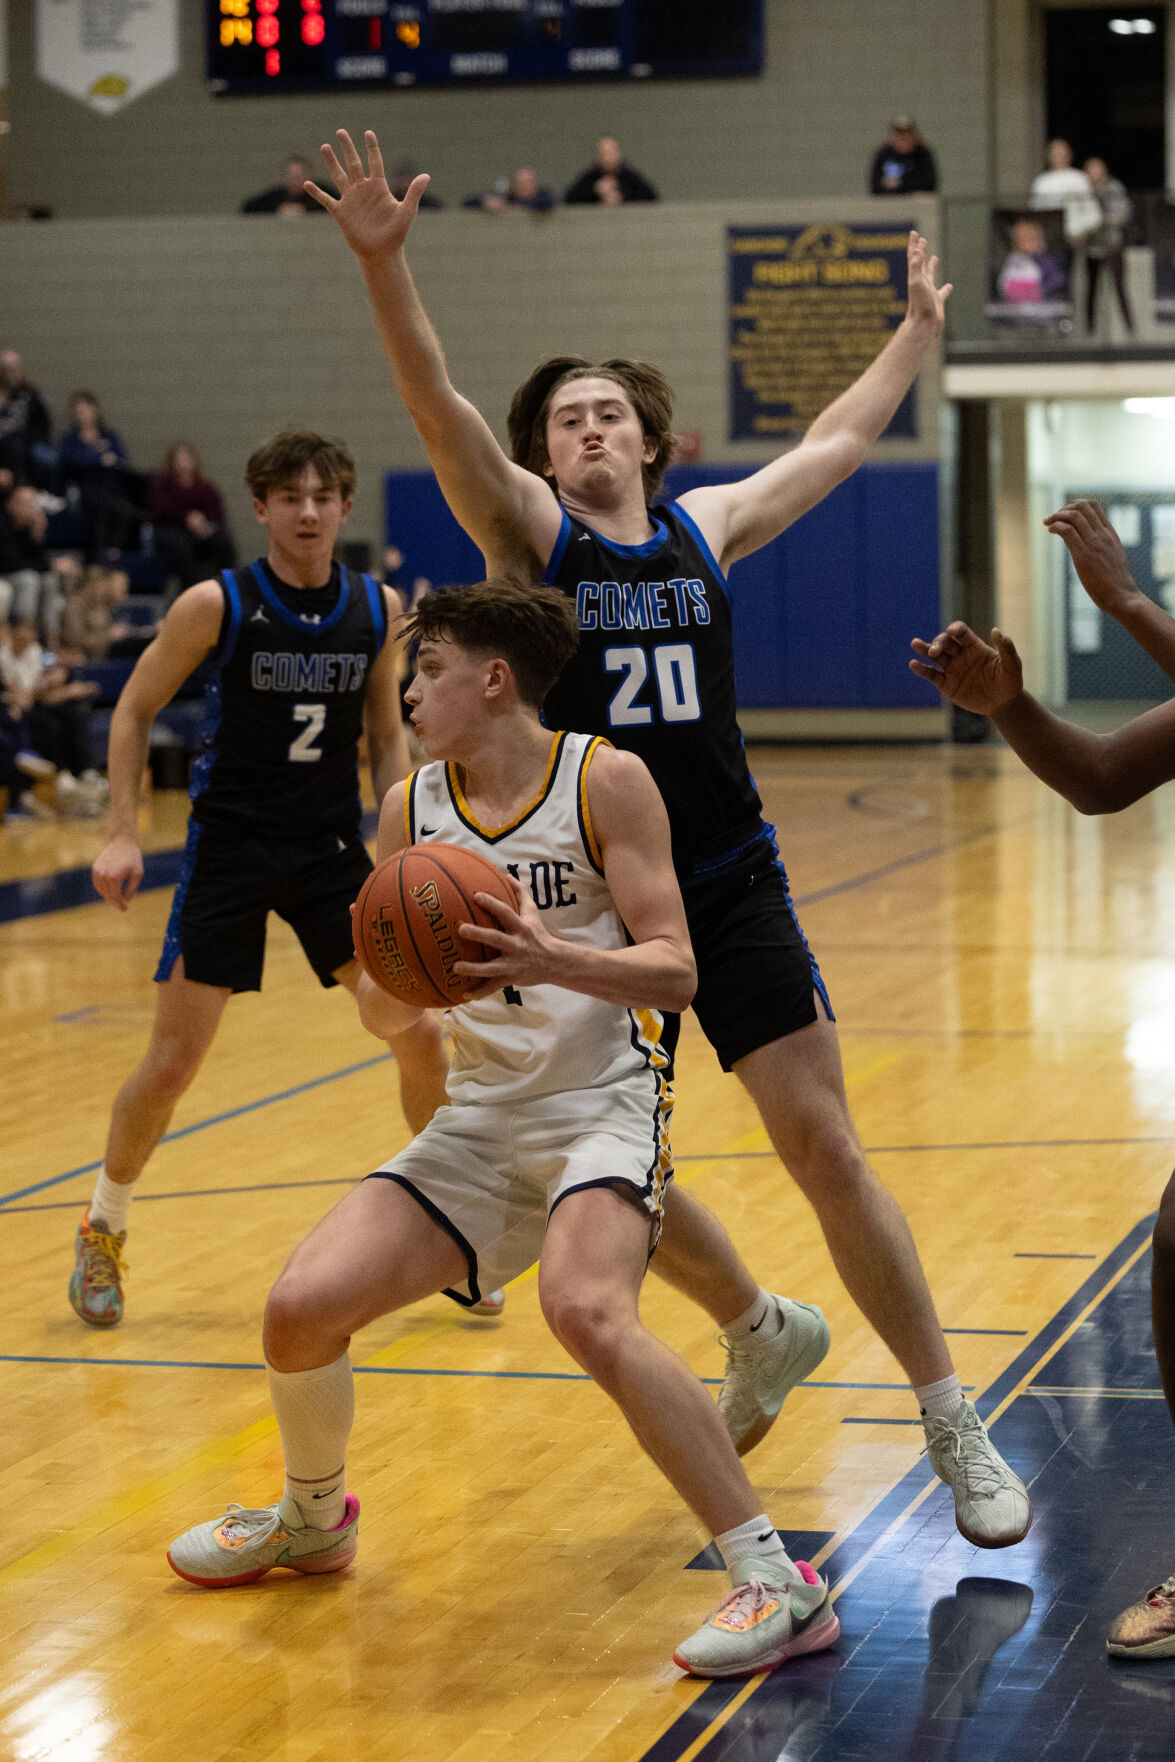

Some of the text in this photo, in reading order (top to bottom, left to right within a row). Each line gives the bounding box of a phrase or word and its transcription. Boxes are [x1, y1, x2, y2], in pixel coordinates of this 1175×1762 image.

[576, 578, 711, 631] COMETS
[251, 650, 368, 693] COMETS
[602, 641, 703, 729] 20
[288, 703, 327, 762] 2
[411, 881, 462, 988] SPALDING
